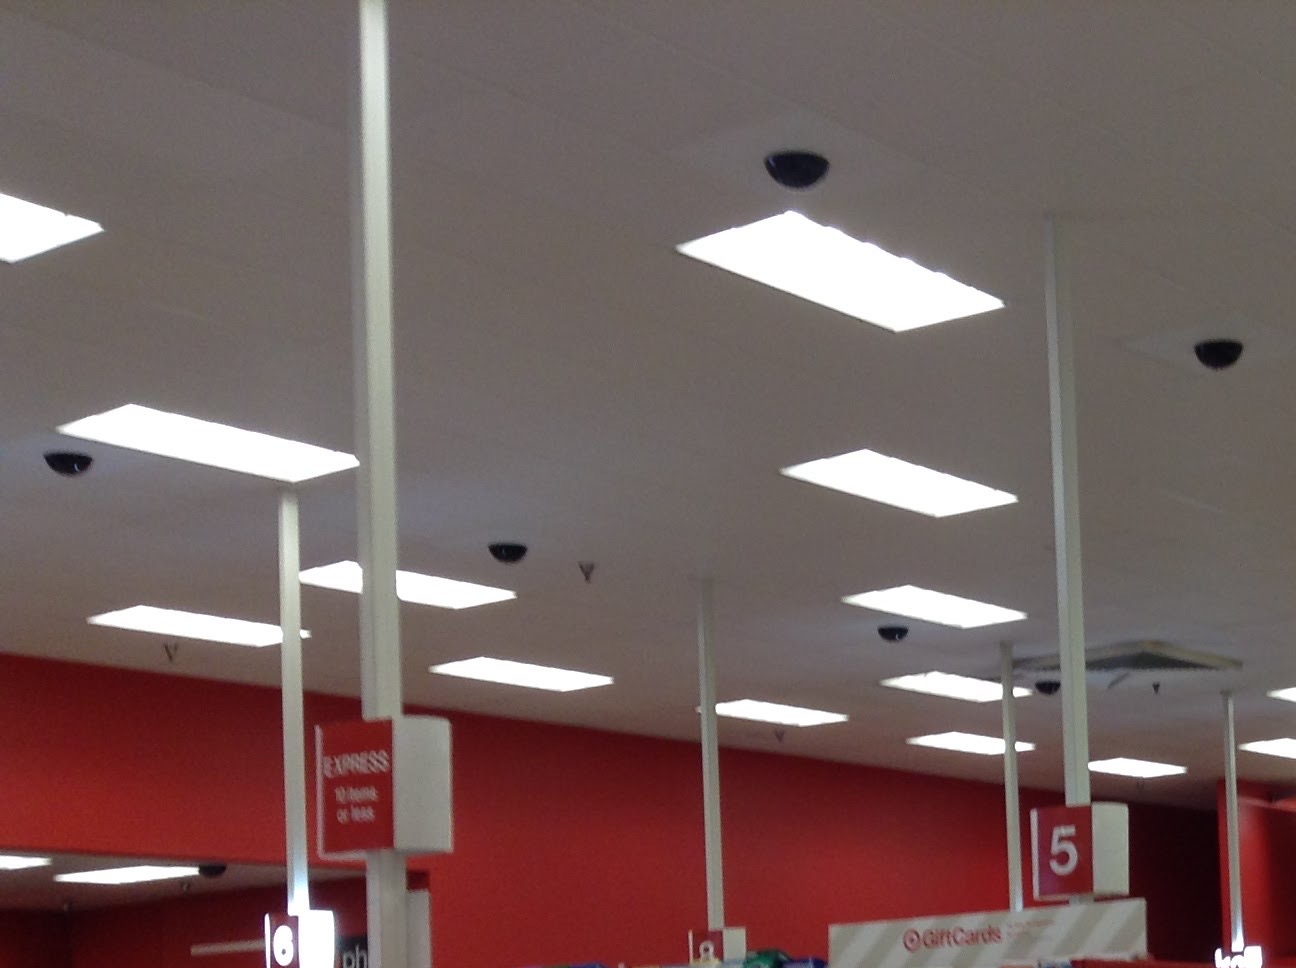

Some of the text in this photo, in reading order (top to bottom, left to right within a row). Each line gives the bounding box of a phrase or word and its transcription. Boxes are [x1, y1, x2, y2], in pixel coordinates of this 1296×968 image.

[322, 749, 390, 779] EXPRESS
[1048, 824, 1080, 877] 5
[922, 926, 1003, 948] GiftCards
